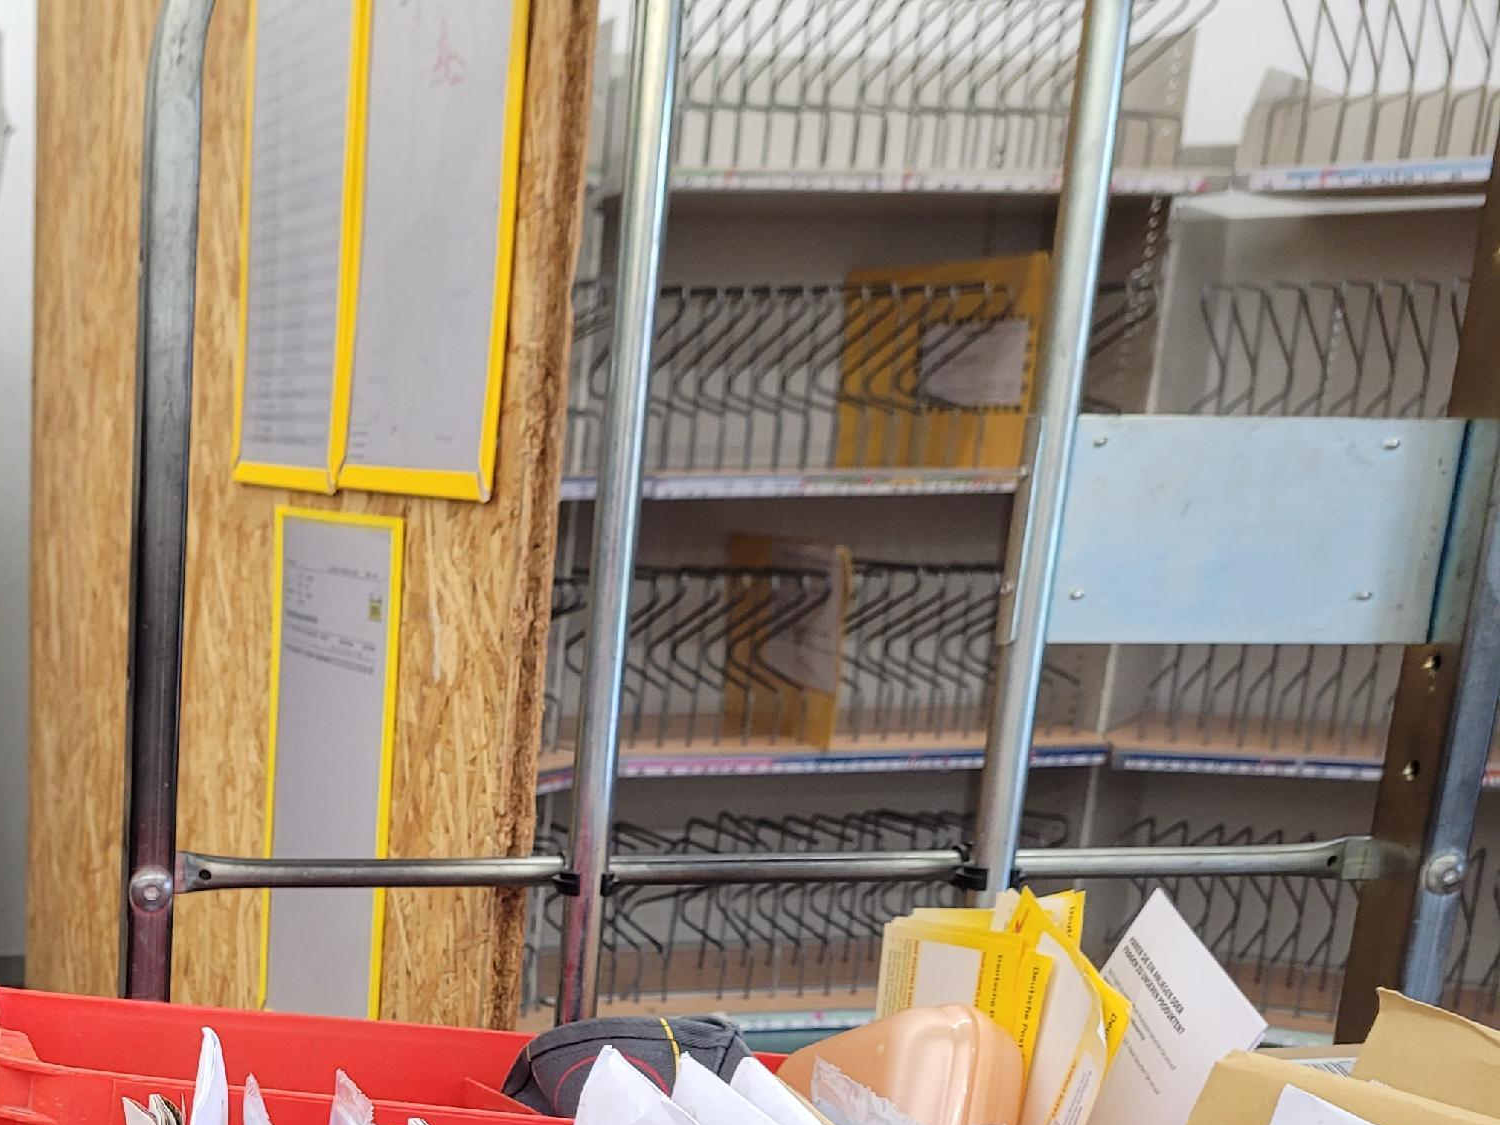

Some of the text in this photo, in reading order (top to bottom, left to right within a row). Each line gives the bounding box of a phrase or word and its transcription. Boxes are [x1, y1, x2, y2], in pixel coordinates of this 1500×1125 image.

[990, 954, 1004, 1007] Deutsche
[1018, 966, 1040, 1048] Deutsche Post
[1122, 945, 1139, 968] FRAGEN
[1141, 972, 1160, 1000] UNSEREN
[1157, 996, 1185, 1035] PRODUKTEN?
[1146, 961, 1156, 974] EIN
[1169, 996, 1184, 1014] ODER
